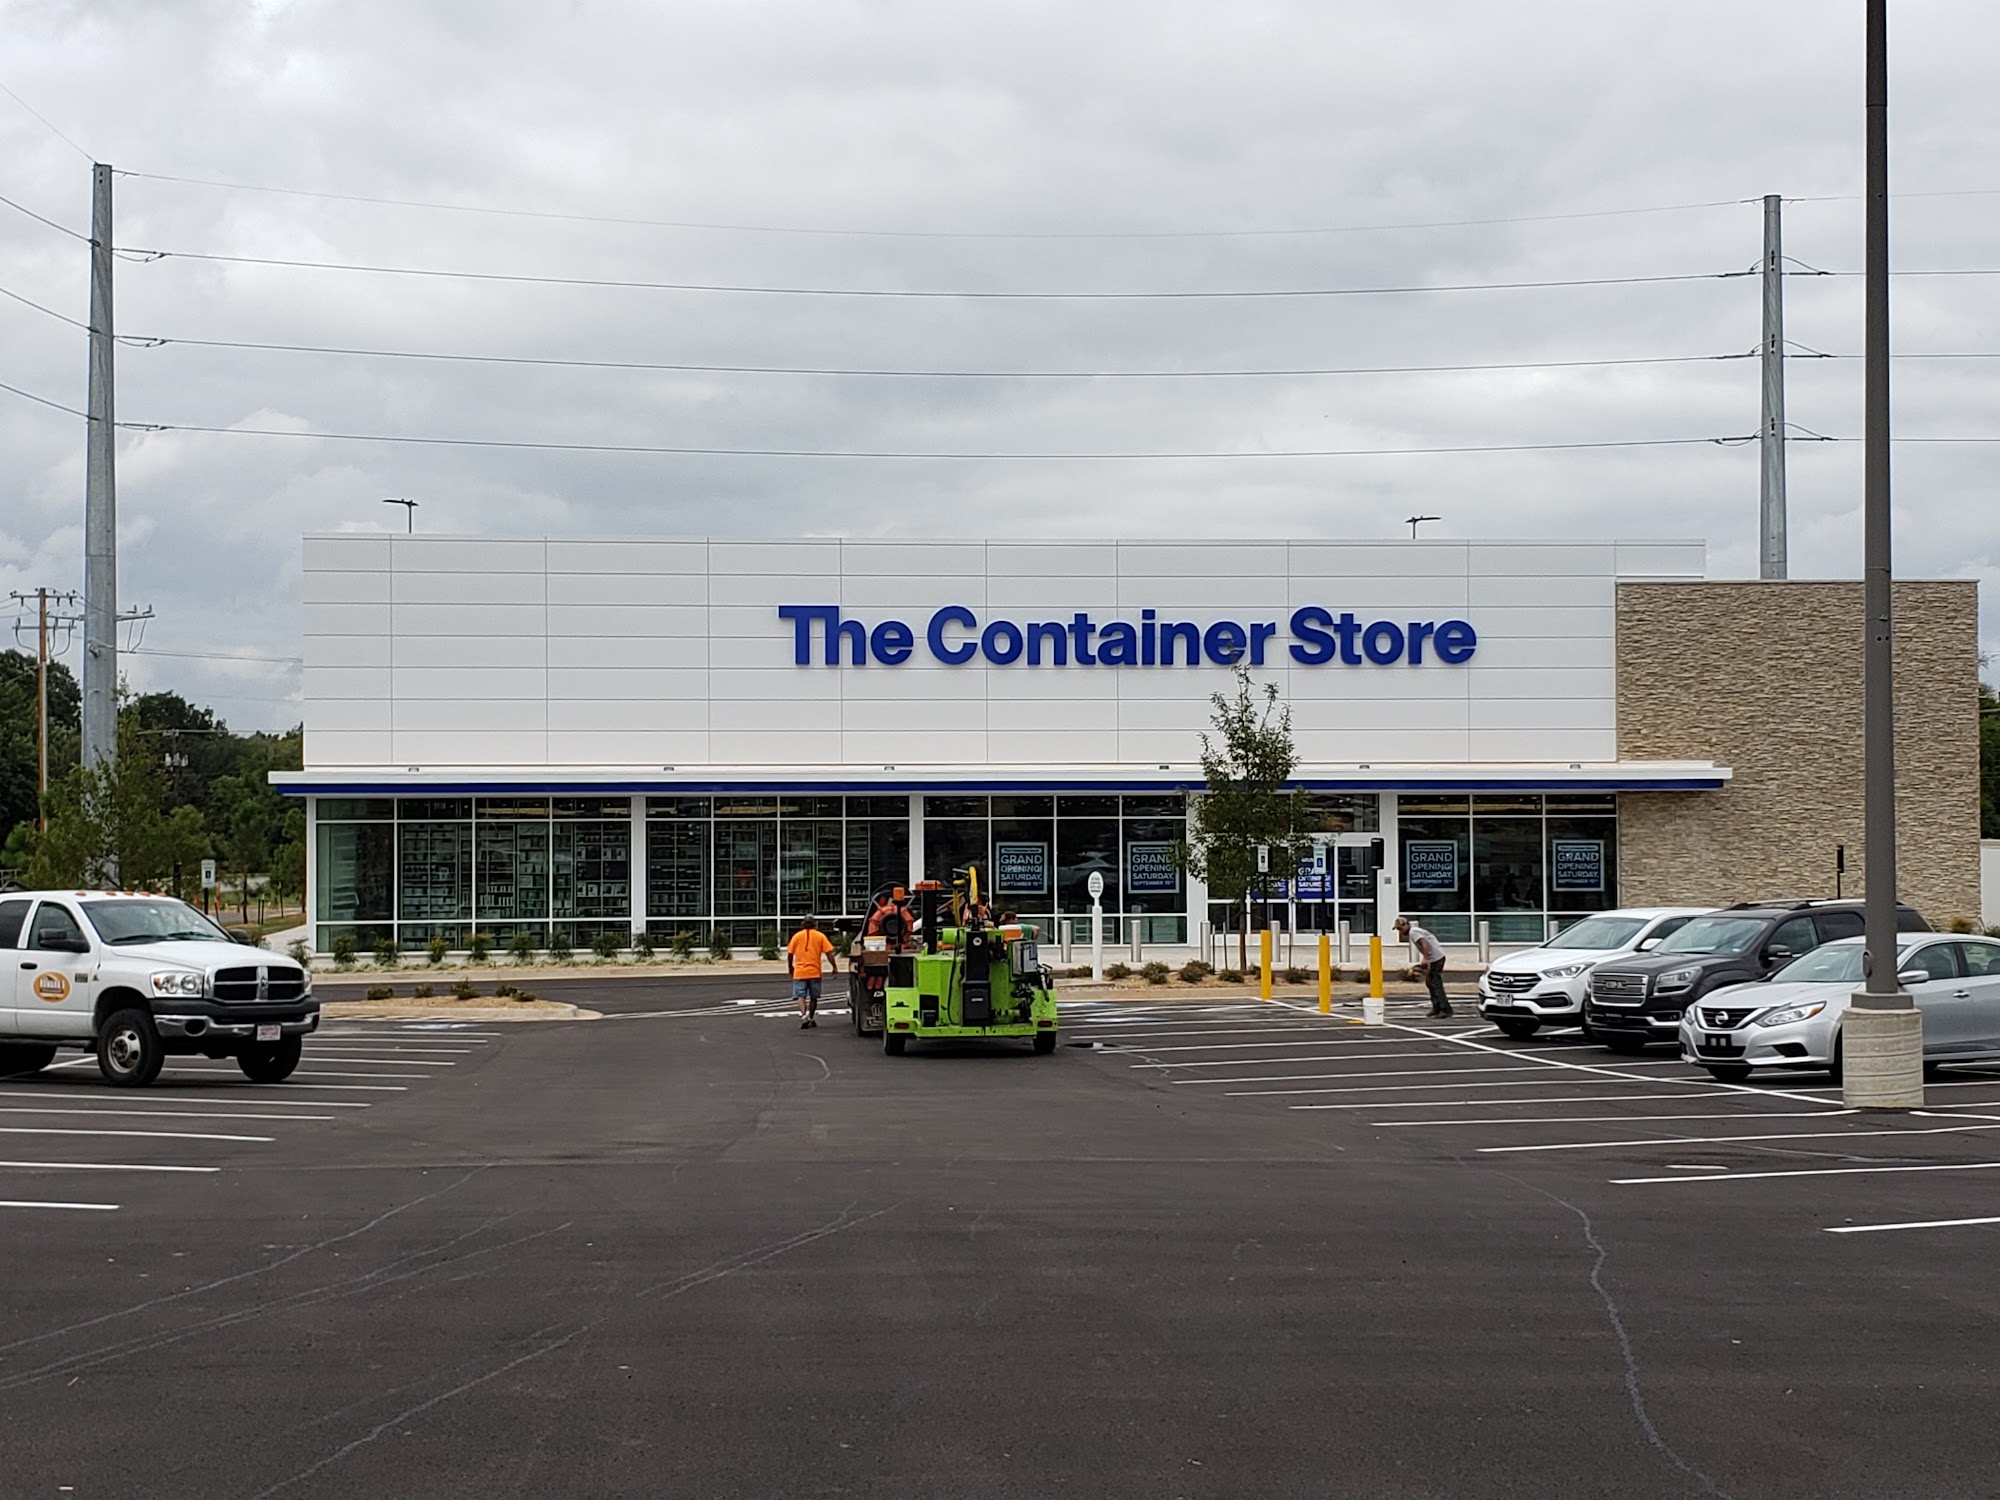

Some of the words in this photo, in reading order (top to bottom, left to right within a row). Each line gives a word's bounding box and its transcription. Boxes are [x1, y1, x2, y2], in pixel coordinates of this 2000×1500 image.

[778, 605, 913, 665] The
[926, 605, 1276, 665] Container
[1289, 606, 1477, 665] Store
[1001, 854, 1043, 864] GRAND
[1411, 852, 1453, 862] GRAND
[1557, 852, 1599, 862] GRAND
[1001, 865, 1043, 873] OPENING!
[1411, 863, 1453, 871] OPENING!
[1557, 862, 1599, 870] OPENING!
[1001, 873, 1043, 881] SATURDAY,
[1132, 872, 1175, 880] SATURDAY,
[1411, 871, 1453, 879] SATURDAY,
[1557, 871, 1599, 879] SATURDAY,
